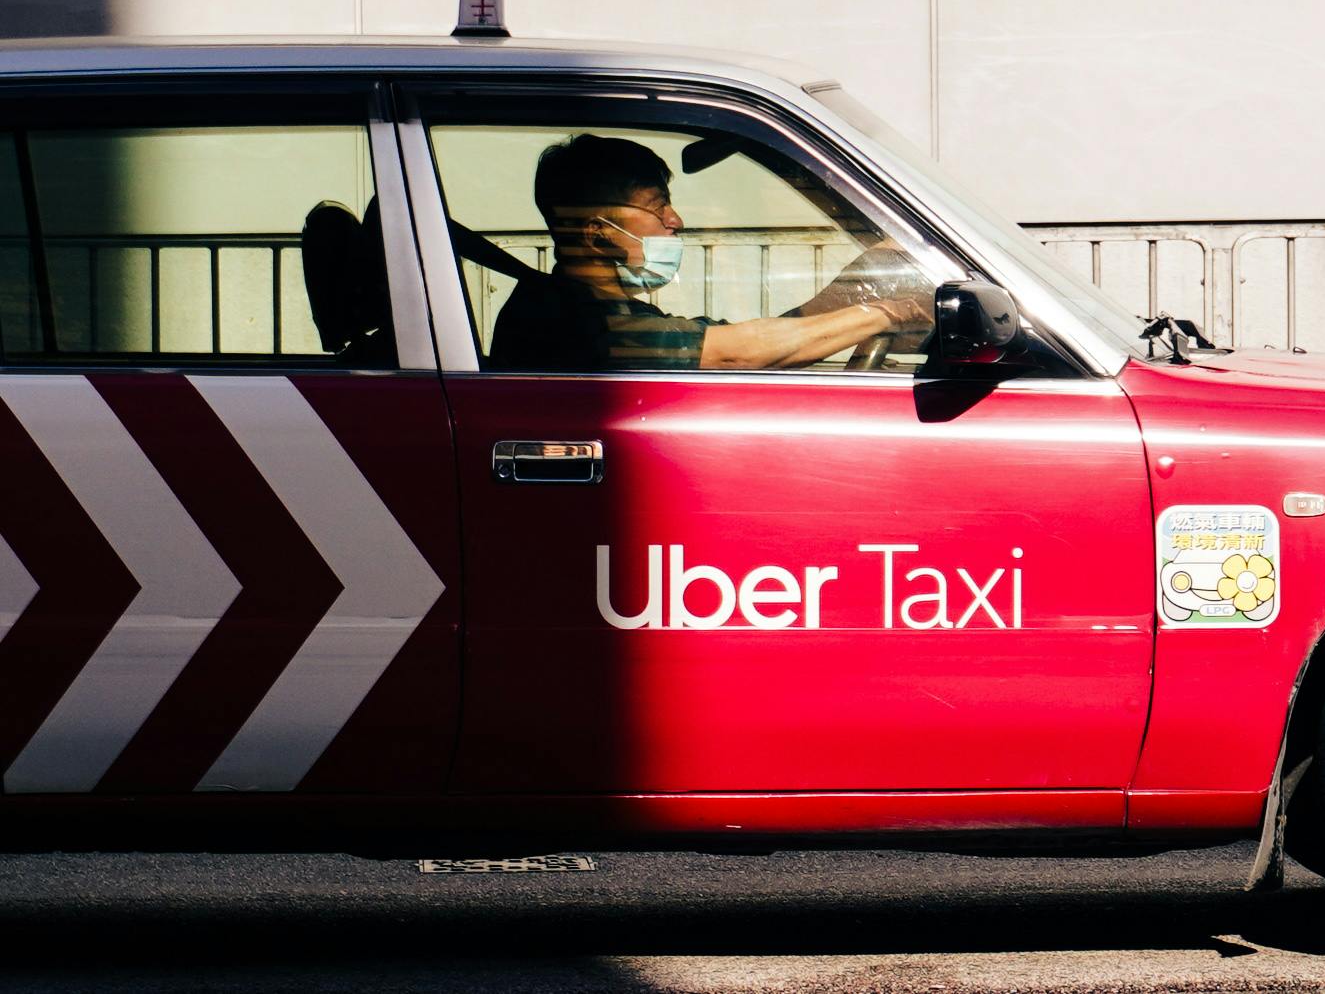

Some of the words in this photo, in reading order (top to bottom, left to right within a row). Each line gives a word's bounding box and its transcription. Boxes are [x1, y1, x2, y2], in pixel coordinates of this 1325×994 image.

[1171, 512, 1265, 531] 燃氣車輛
[1172, 534, 1265, 550] 環境清新
[597, 545, 838, 630] Uber
[858, 544, 1023, 629] Taxi
